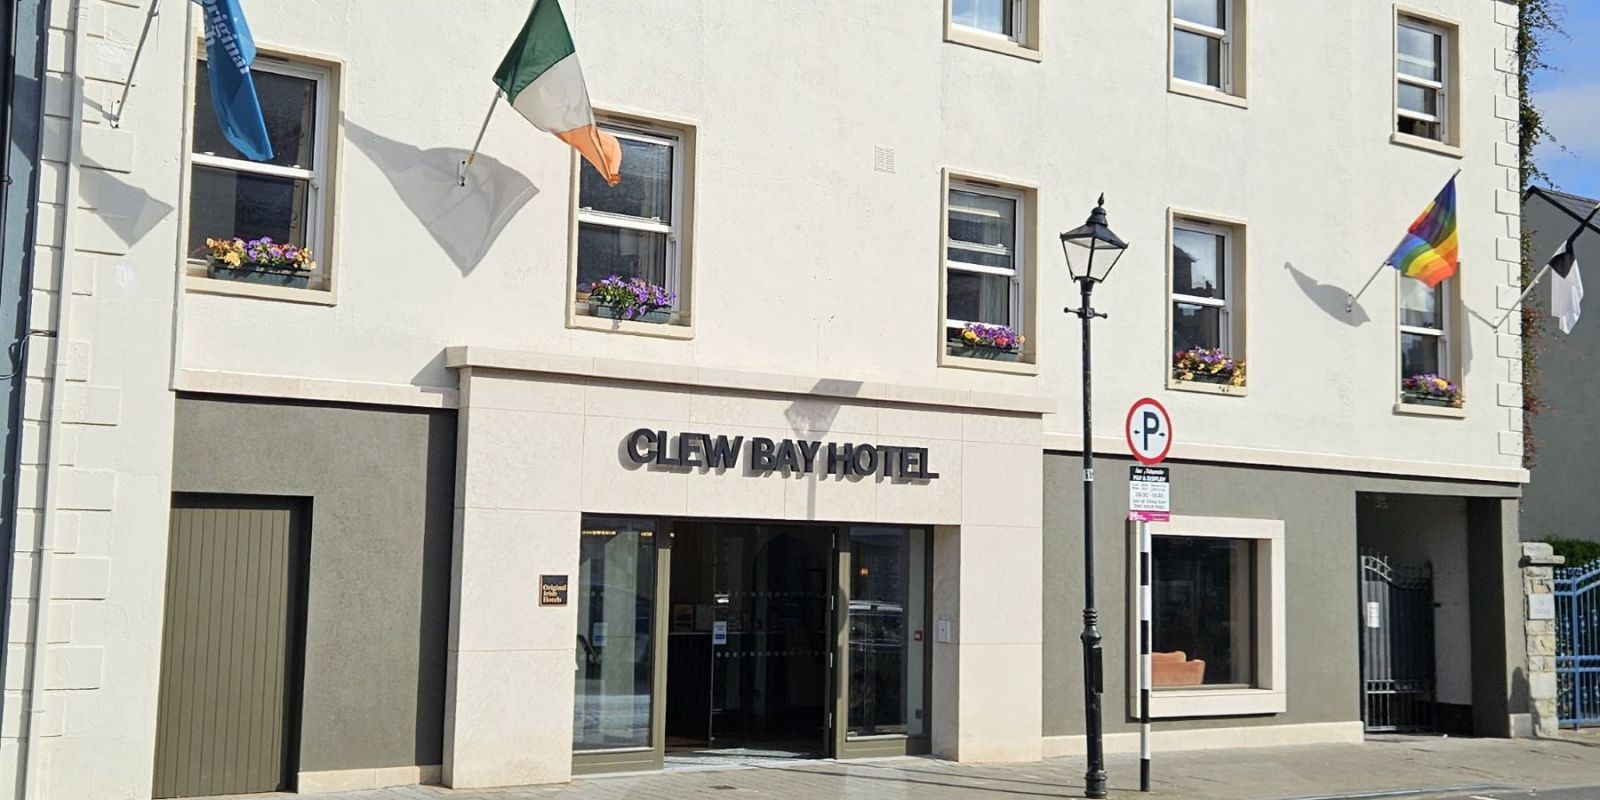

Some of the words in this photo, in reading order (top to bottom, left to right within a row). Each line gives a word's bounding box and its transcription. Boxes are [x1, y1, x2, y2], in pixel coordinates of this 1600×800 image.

[627, 428, 743, 469] CLEW
[752, 437, 821, 473] BAY
[828, 442, 940, 479] HOTEL
[1143, 411, 1160, 451] P
